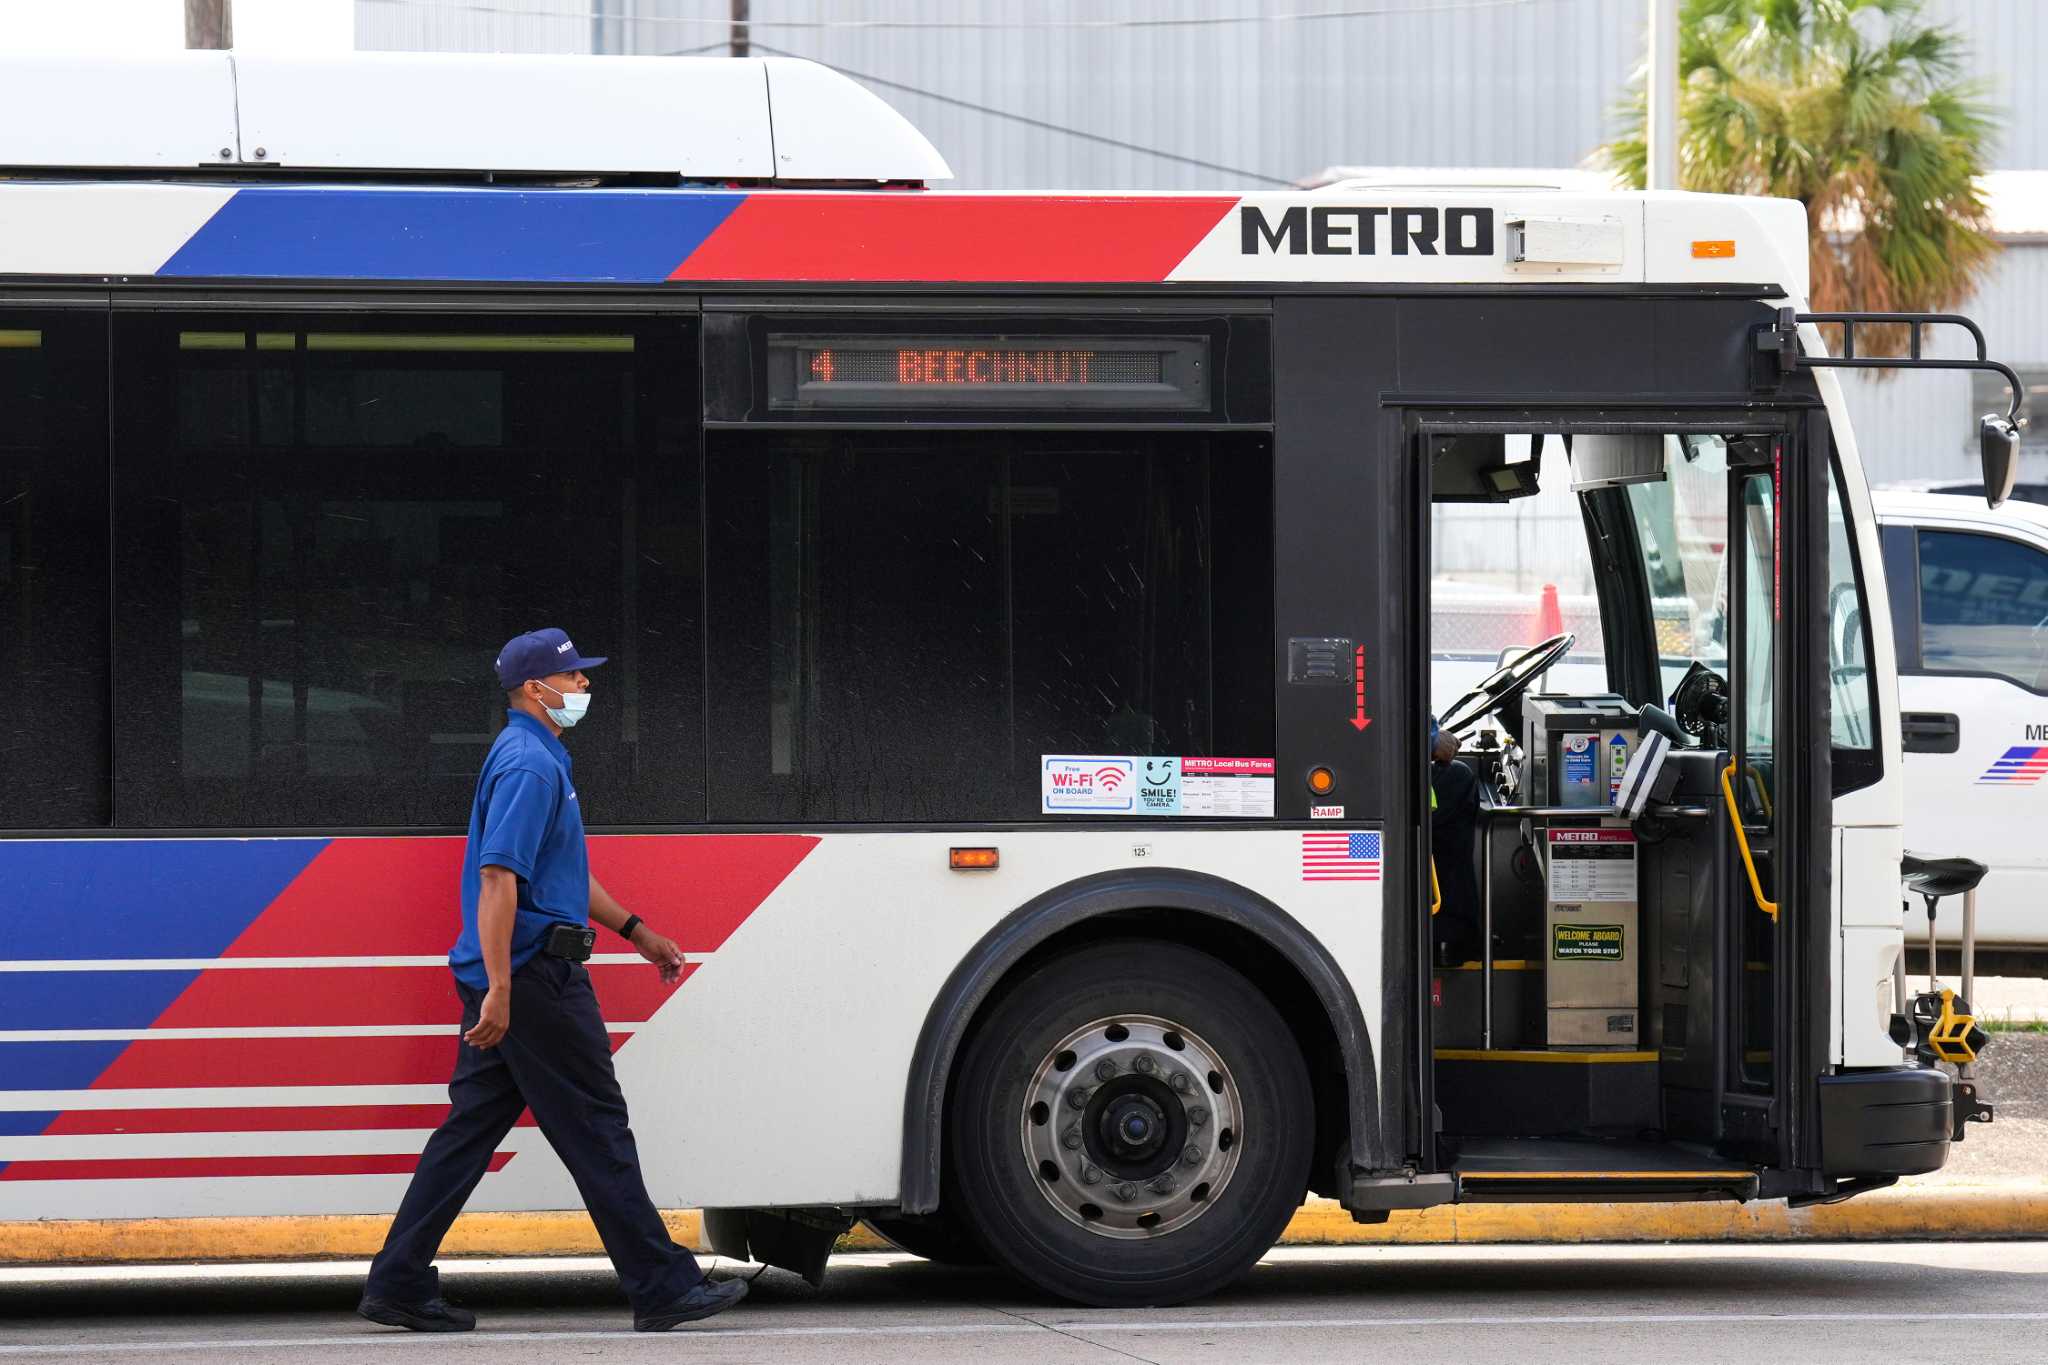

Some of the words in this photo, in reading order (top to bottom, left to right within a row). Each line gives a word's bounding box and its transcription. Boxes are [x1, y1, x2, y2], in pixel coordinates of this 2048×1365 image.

[1241, 206, 1494, 256] METRO
[811, 349, 835, 382] 4
[898, 350, 1094, 383] BEECHNUT
[1184, 759, 1213, 767] METRO
[1214, 760, 1234, 768] Local
[1235, 760, 1249, 768] Bus
[1052, 773, 1093, 787] Wi-Fi
[1053, 787, 1064, 795] ON
[1140, 788, 1176, 798] SMILE!
[1312, 807, 1342, 817] RAMP
[1556, 832, 1598, 841] METRO
[1557, 930, 1591, 941] WELCOME
[1593, 931, 1620, 941] ABOARD
